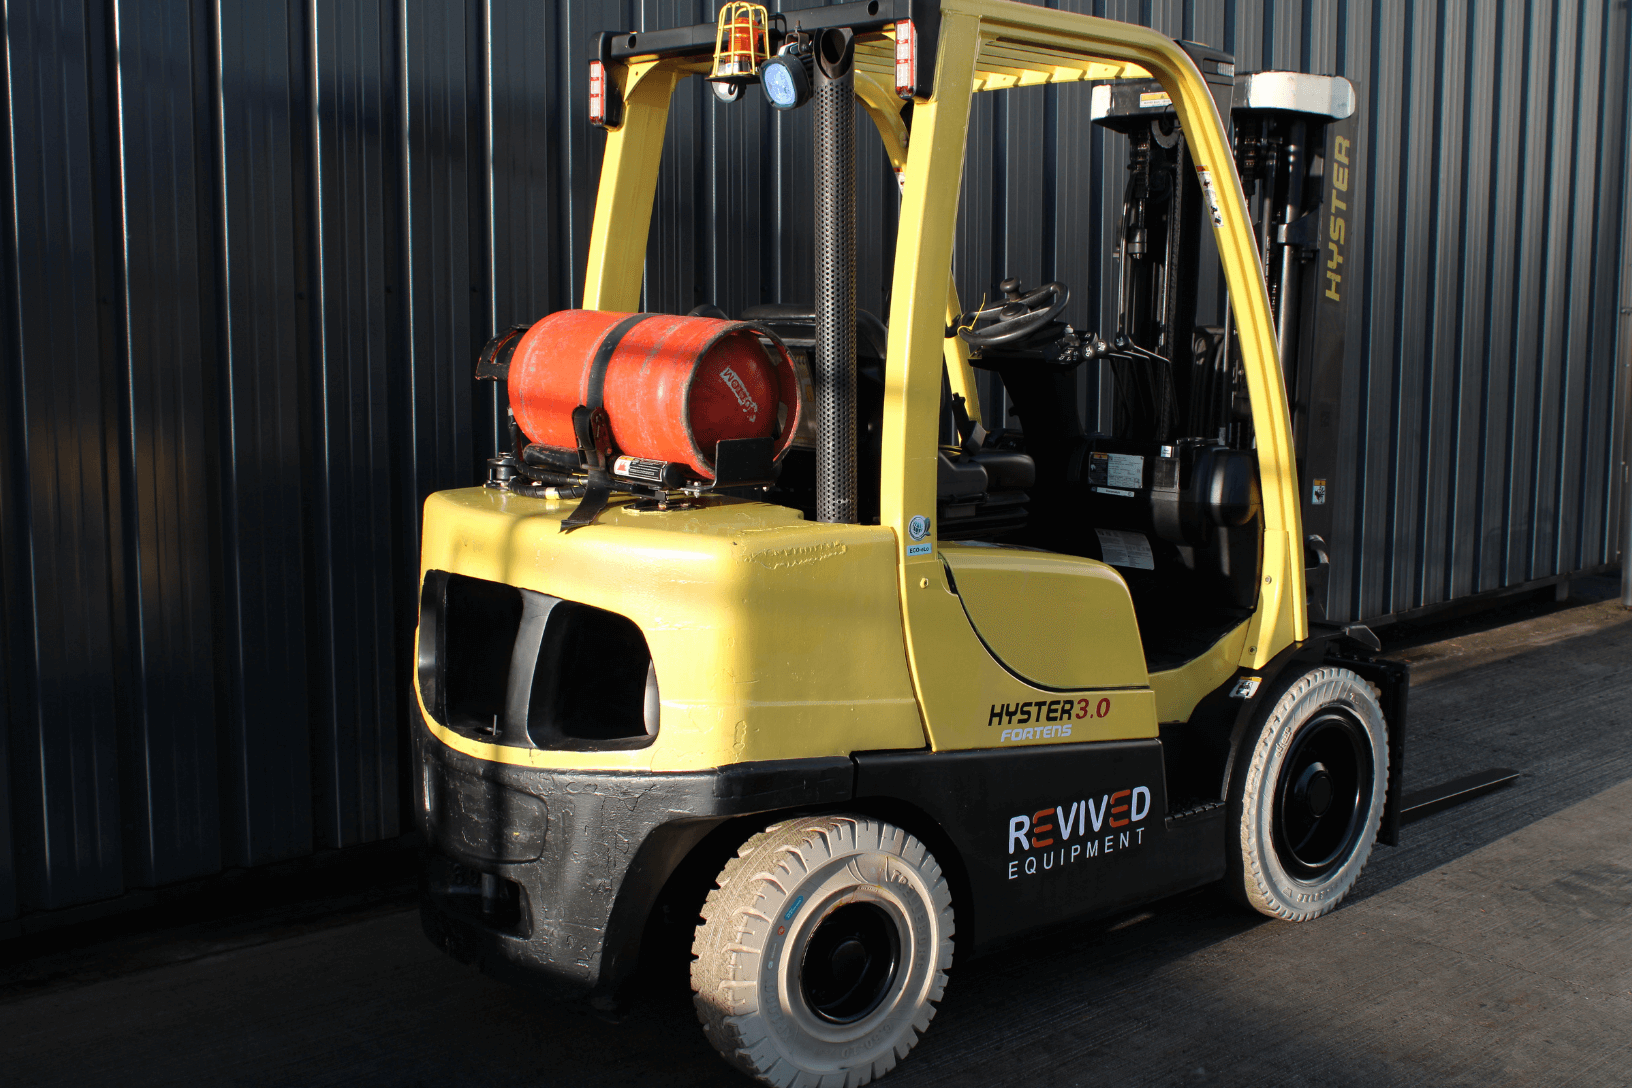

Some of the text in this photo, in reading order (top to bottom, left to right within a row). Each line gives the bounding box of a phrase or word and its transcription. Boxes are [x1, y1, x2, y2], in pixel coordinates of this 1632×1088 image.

[1325, 135, 1350, 302] HYSTER
[988, 698, 1111, 727] HYSTER 3.0
[1001, 724, 1073, 742] FORTENS
[1008, 785, 1151, 855] REVIVED
[1008, 827, 1145, 880] EQUIPMENT
[890, 868, 928, 970] TRELLEBORG
